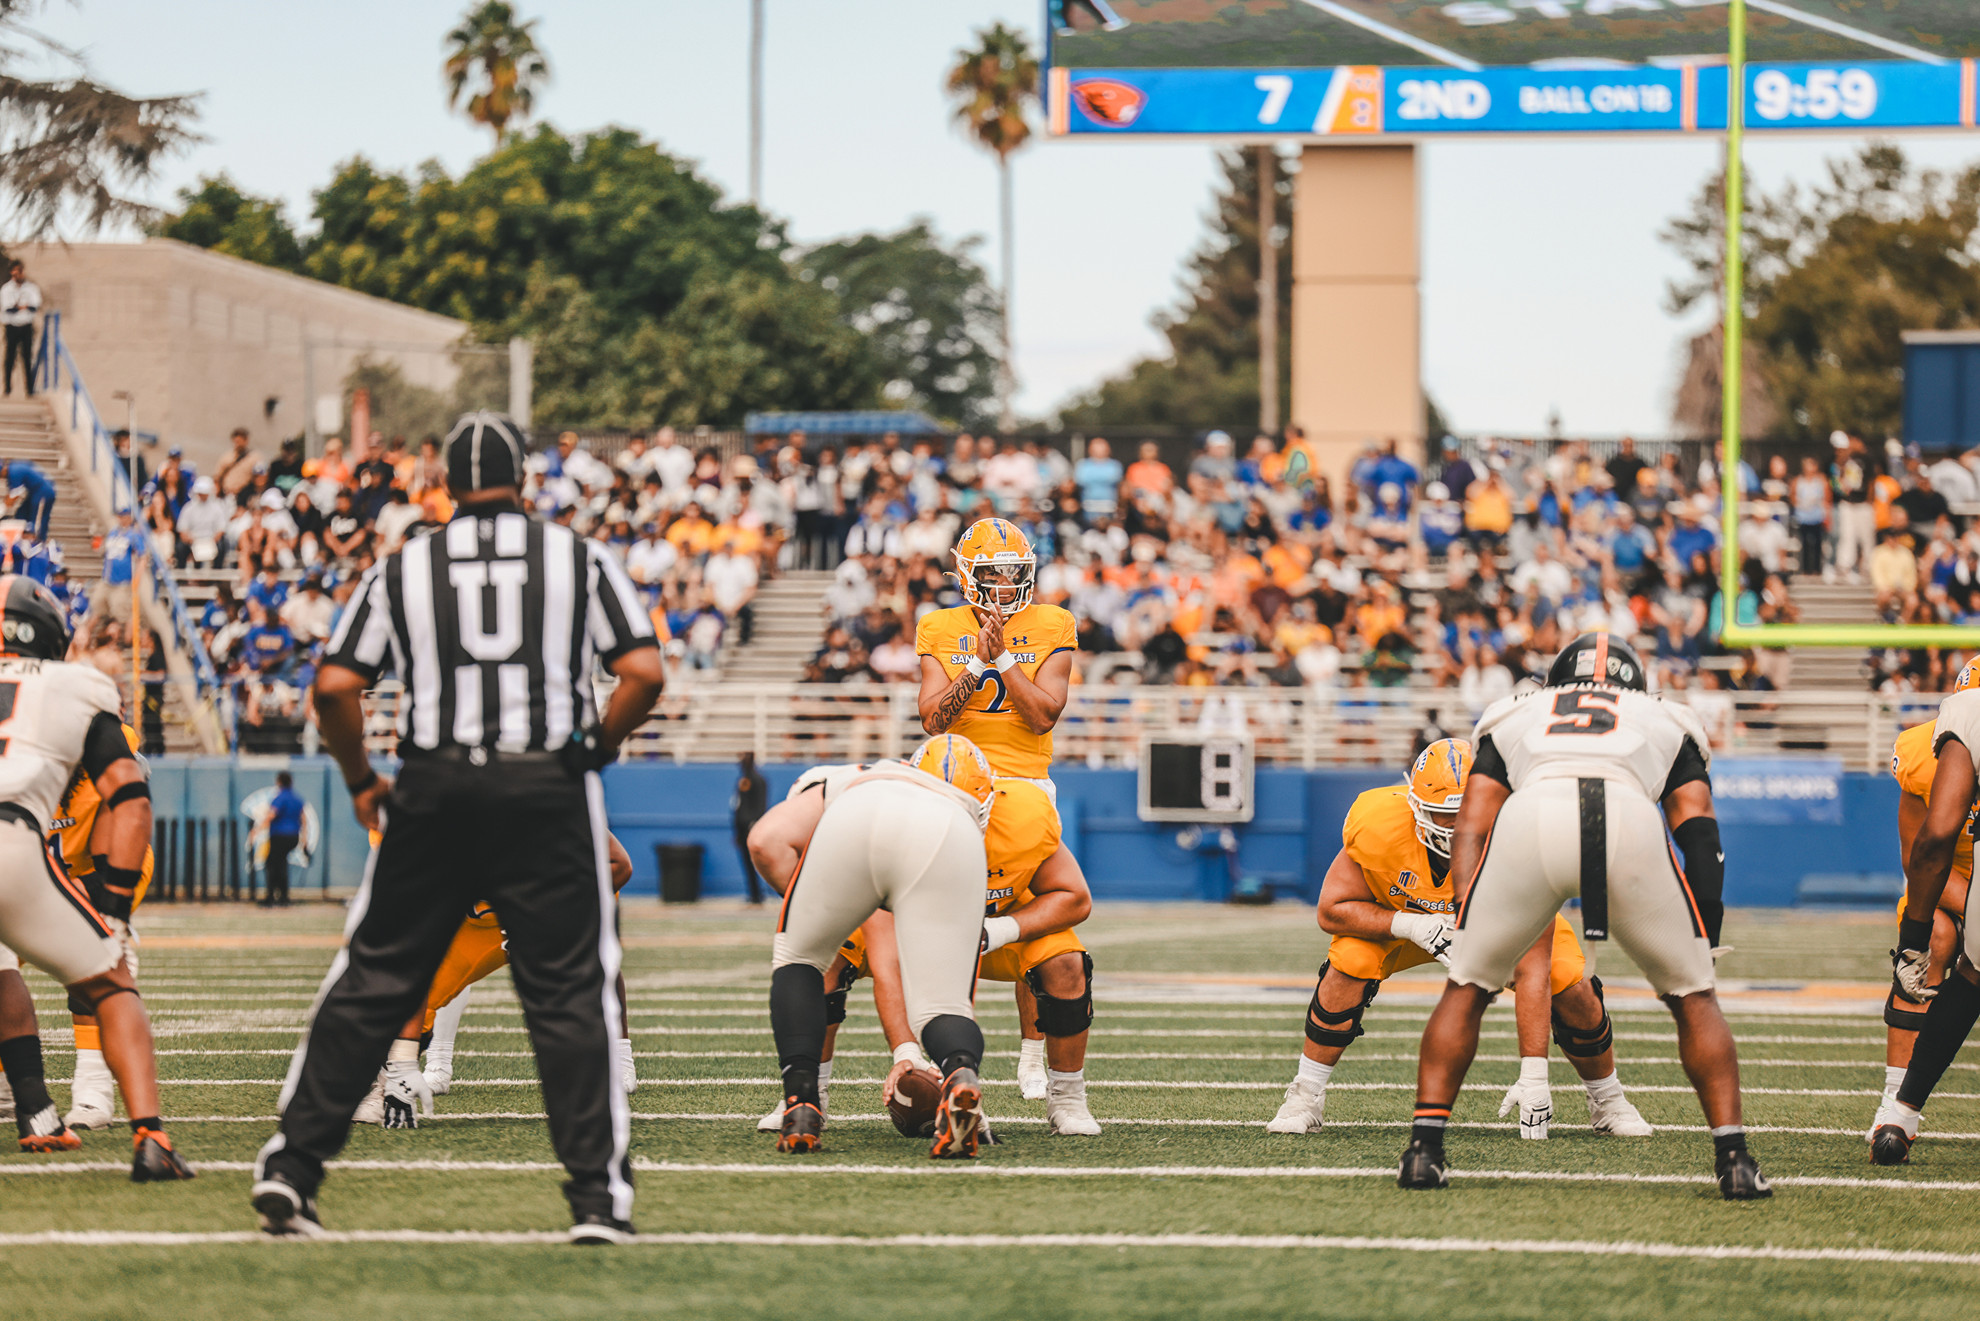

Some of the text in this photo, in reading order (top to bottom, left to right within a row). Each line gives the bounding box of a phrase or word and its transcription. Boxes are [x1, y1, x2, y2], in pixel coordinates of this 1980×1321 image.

[1254, 75, 1293, 125] 7
[1397, 79, 1491, 120] 2ND
[1519, 85, 1592, 114] BALL
[1590, 84, 1640, 113] ON
[1753, 68, 1877, 120] 9:59
[449, 560, 527, 661] U
[1010, 653, 1036, 663] TATE
[974, 667, 1012, 713] 2
[1545, 689, 1620, 736] 5
[1200, 742, 1243, 811] 8
[49, 817, 76, 830] TATE
[986, 887, 1014, 900] TATE
[1389, 885, 1412, 899] SA
